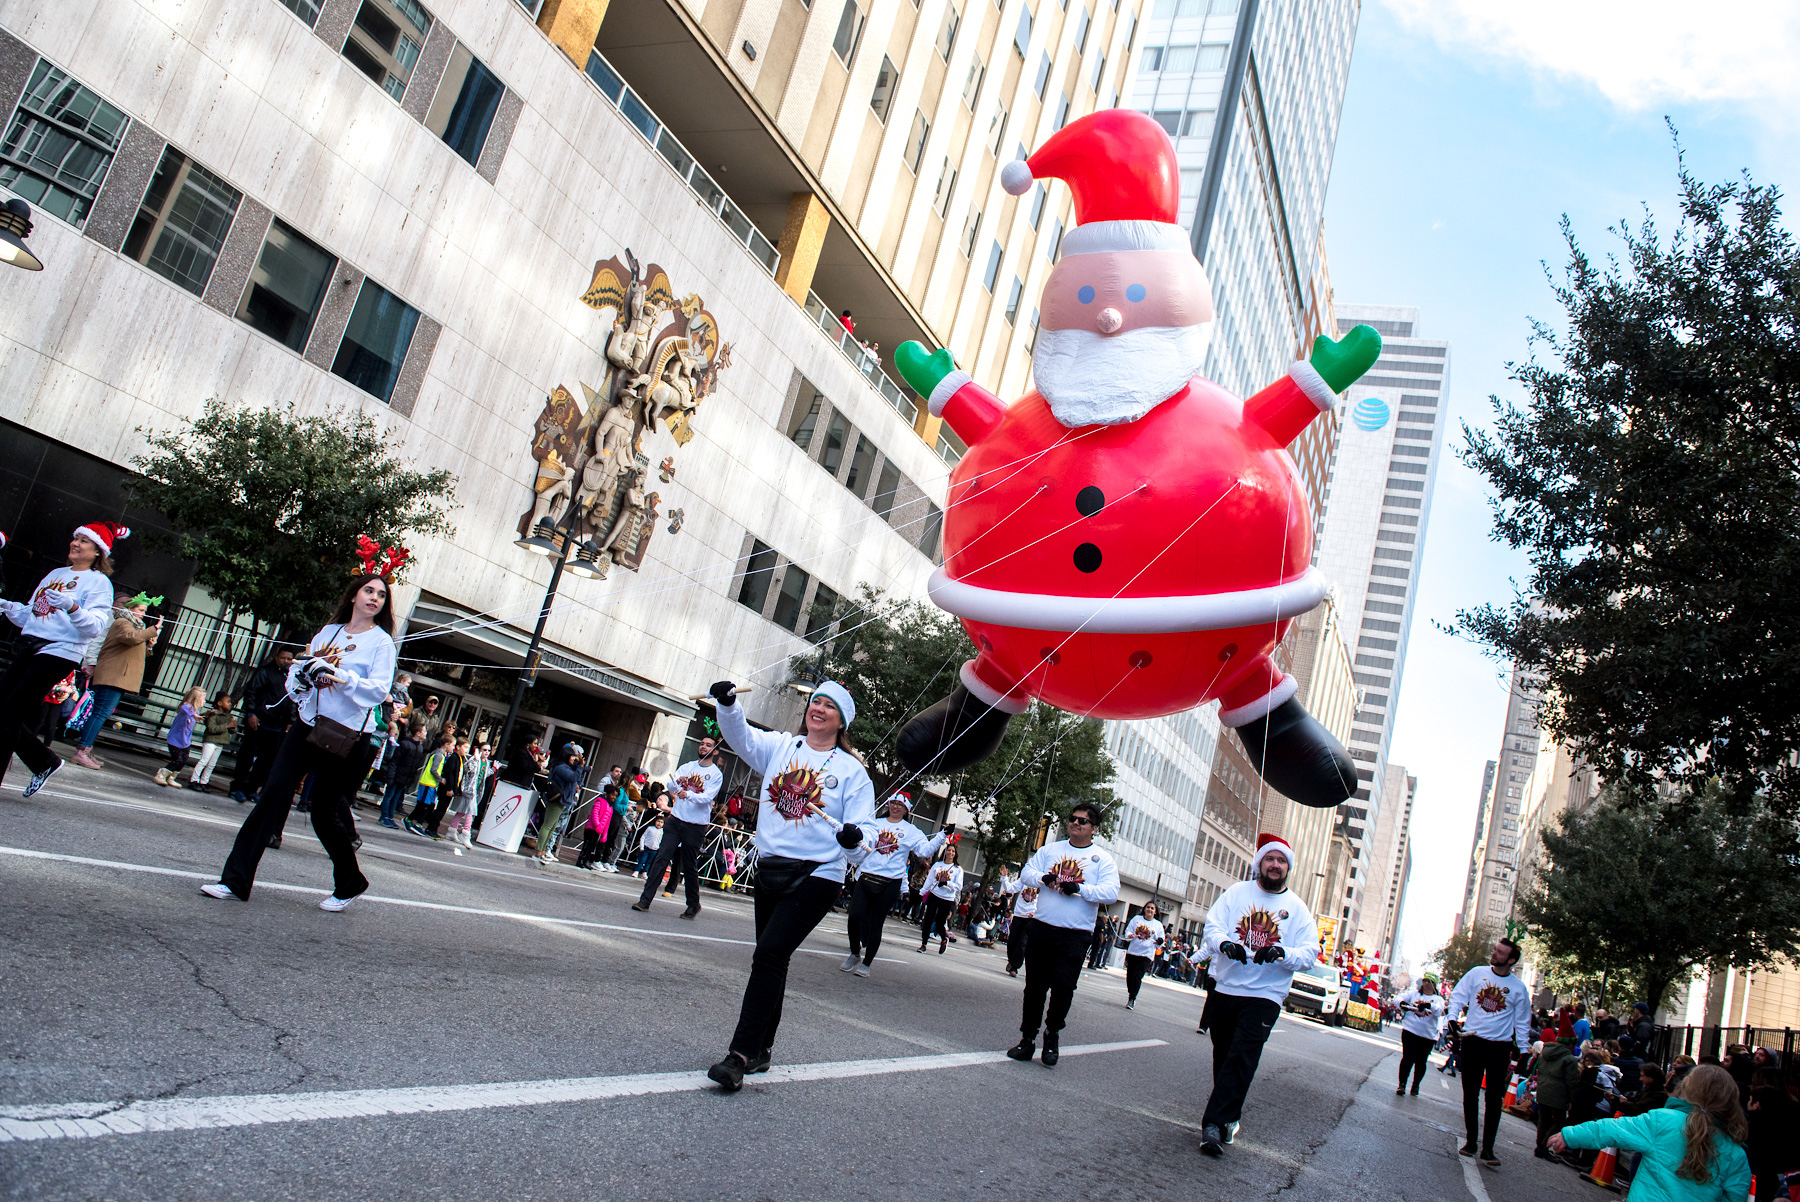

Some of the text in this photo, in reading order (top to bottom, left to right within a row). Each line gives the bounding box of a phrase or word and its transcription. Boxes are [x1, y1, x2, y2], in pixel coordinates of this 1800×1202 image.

[541, 652, 600, 682] CONTINENTAL
[602, 675, 640, 695] BUILDING
[782, 790, 807, 804] DALLAS
[495, 802, 511, 824] ACT
[778, 802, 803, 817] PARADE
